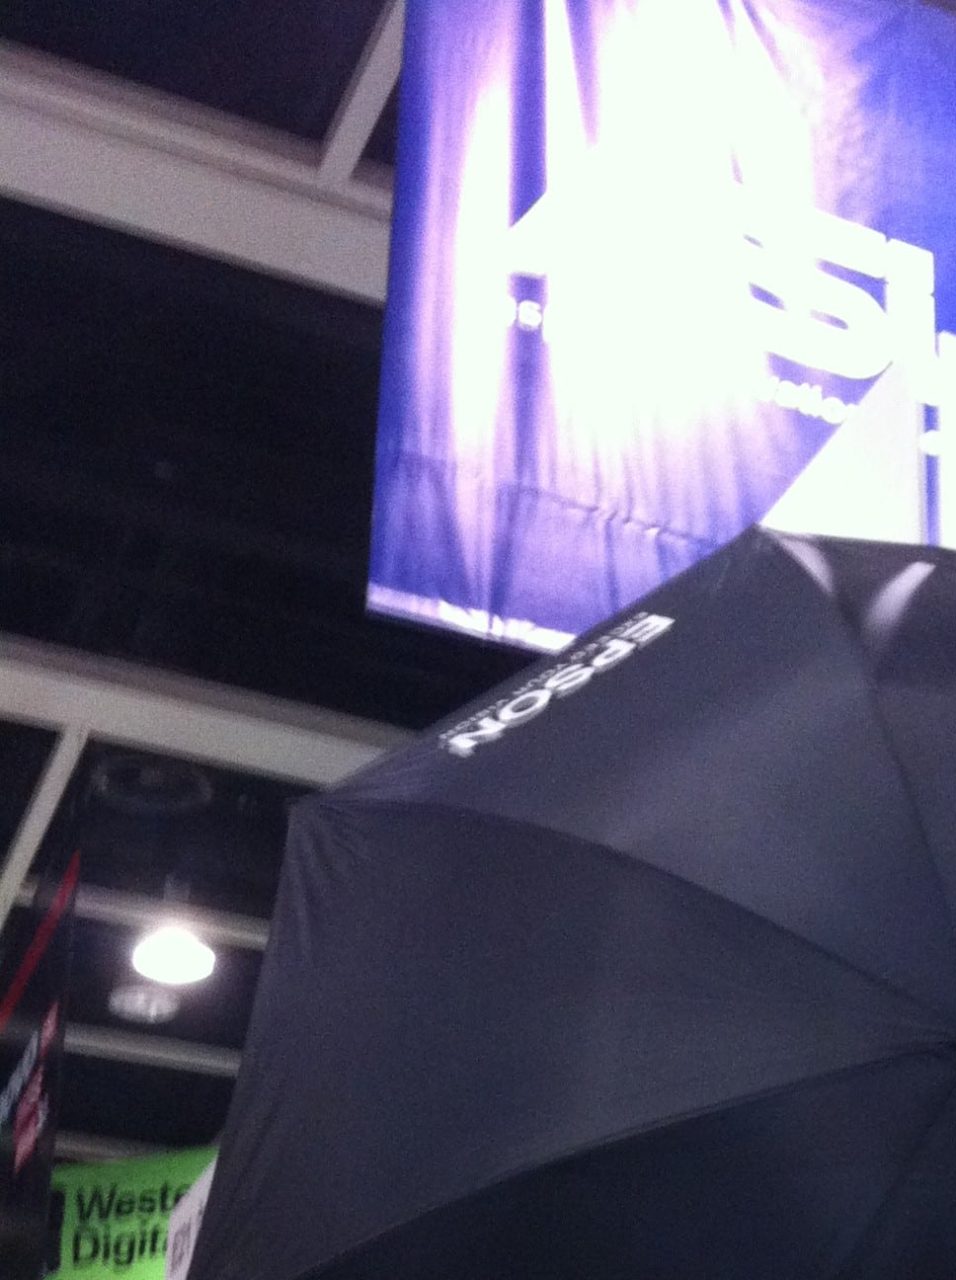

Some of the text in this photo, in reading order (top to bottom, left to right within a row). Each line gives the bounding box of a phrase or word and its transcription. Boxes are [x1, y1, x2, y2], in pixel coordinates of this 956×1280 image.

[449, 613, 676, 757] EPSON
[75, 1182, 188, 1223] West
[71, 1222, 168, 1273] Digit
